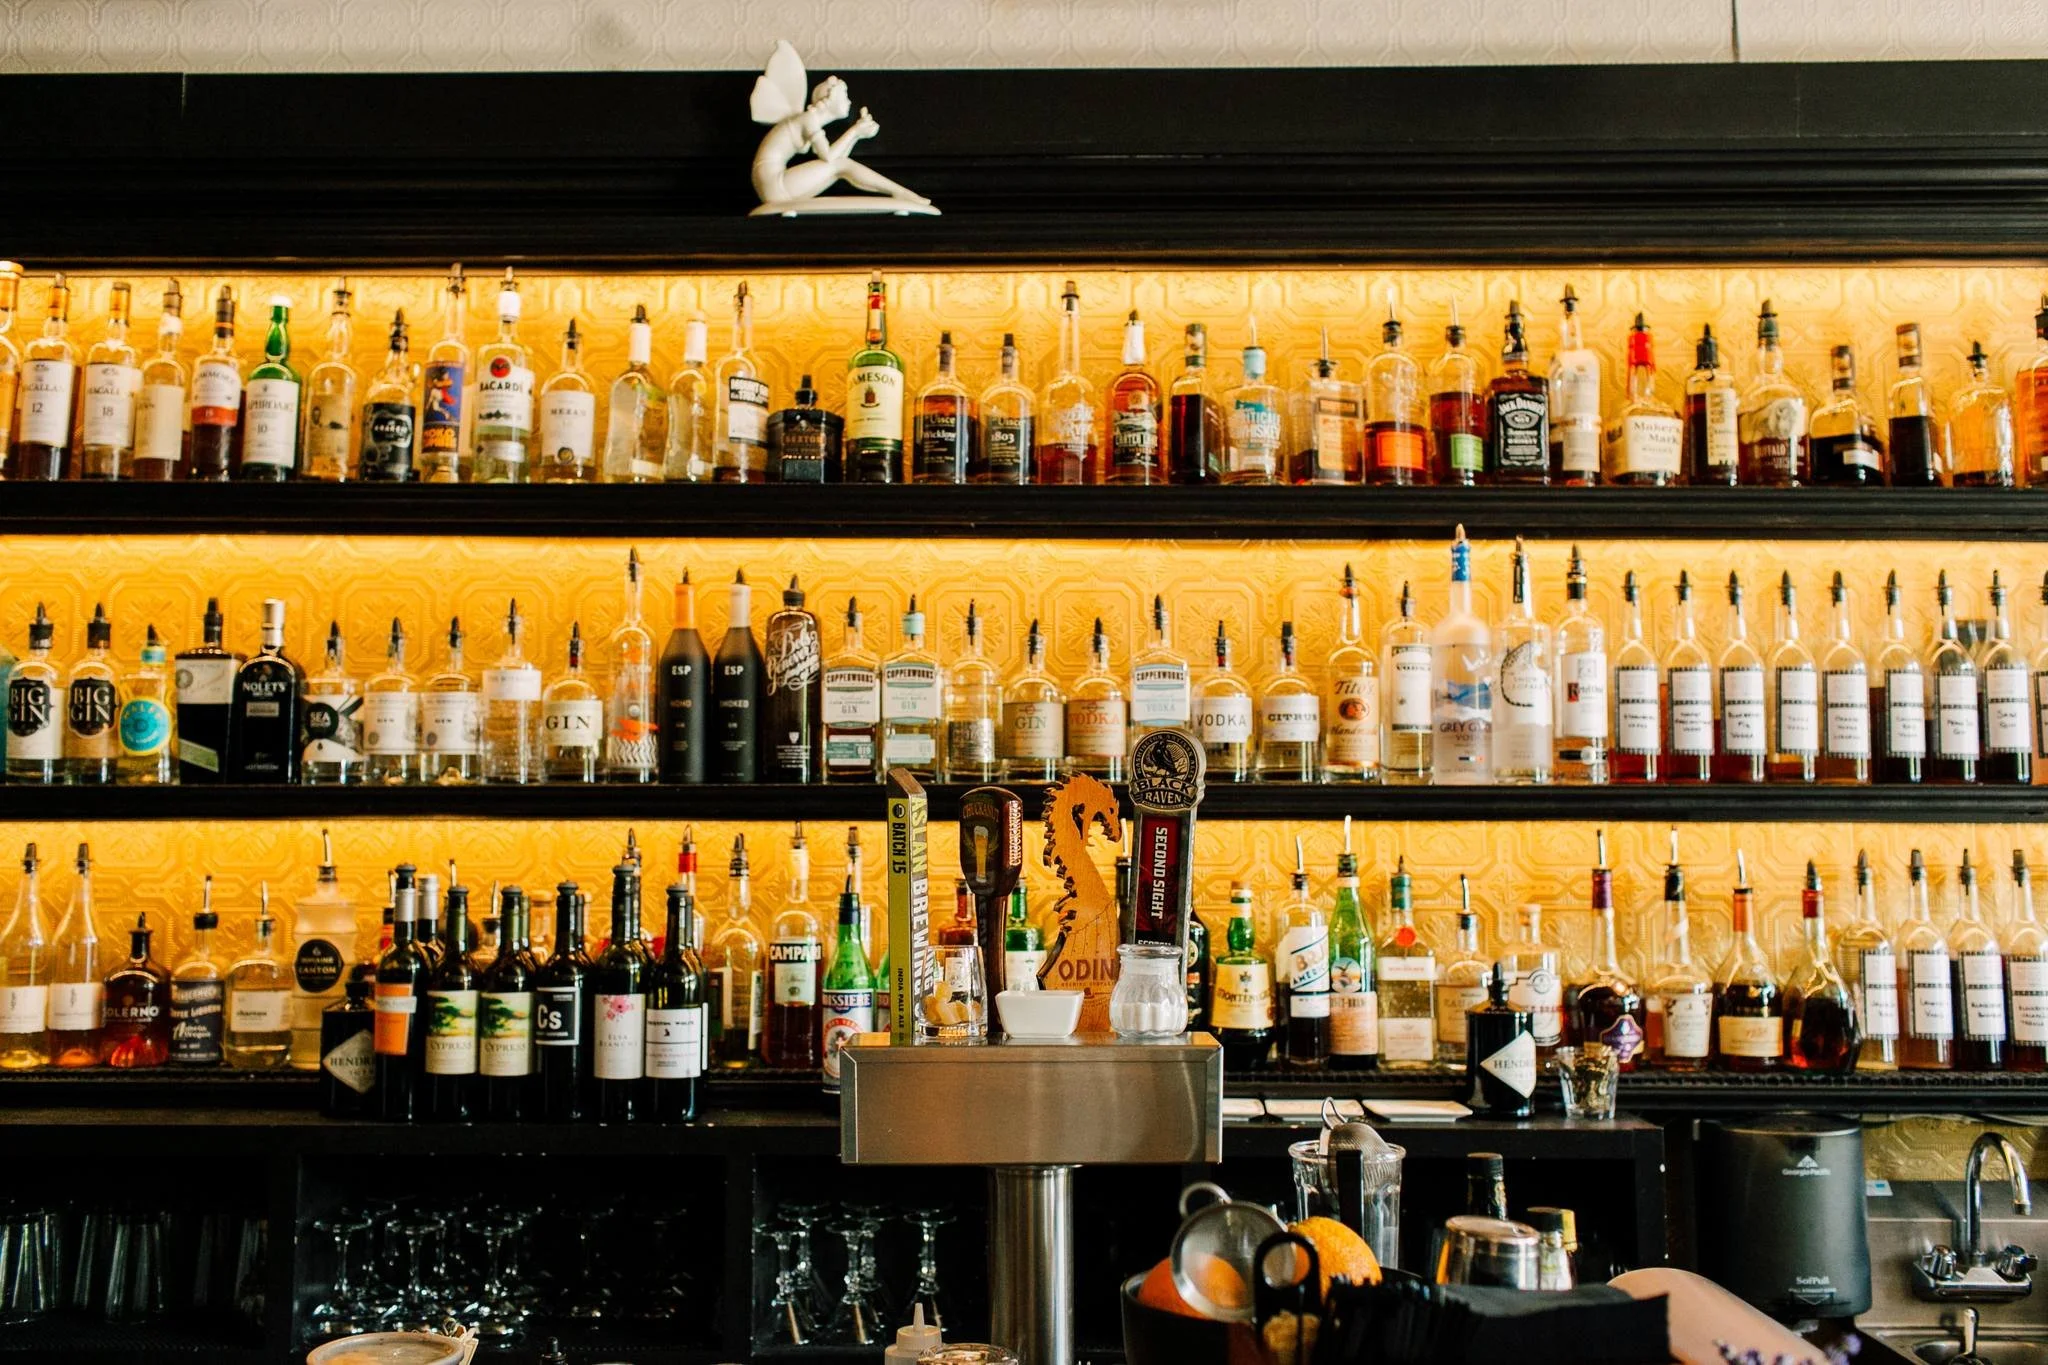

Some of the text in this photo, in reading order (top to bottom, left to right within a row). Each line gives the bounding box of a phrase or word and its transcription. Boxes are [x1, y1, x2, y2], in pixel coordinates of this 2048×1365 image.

[31, 402, 43, 414] 12
[102, 407, 114, 417] 18
[257, 424, 268, 433] 10
[991, 431, 1015, 444] 1803
[672, 665, 692, 675] ESP
[724, 665, 744, 675] ESP
[887, 669, 934, 679] COPPERWORKS
[1136, 670, 1184, 681] COPPERWORKS
[826, 673, 874, 684] COPPERWORKS
[11, 687, 45, 705] BIG
[74, 686, 110, 705] BIG
[841, 705, 858, 714] GIN
[901, 701, 917, 710] GIN
[1145, 703, 1176, 712] VODKA
[8, 704, 46, 722] GIN
[71, 704, 110, 722] GIN
[310, 712, 331, 721] SEA
[1068, 711, 1120, 727] VODKA
[546, 715, 592, 730] GIN
[1014, 716, 1047, 730] GIN
[1197, 714, 1247, 727] VODKA
[1440, 722, 1468, 734] GREY
[1138, 777, 1197, 798] BLACK
[1145, 791, 1182, 804] RAVEN
[911, 797, 928, 874] ASLAN
[892, 822, 907, 874] BATCH 15
[1151, 826, 1168, 920] SECOND SIGHT
[770, 945, 822, 960] CAMPARI
[1058, 958, 1117, 982] ODIN
[537, 1004, 563, 1030] Cs
[430, 1040, 473, 1051] CYPRESS
[485, 1042, 526, 1053] CYPRESS
